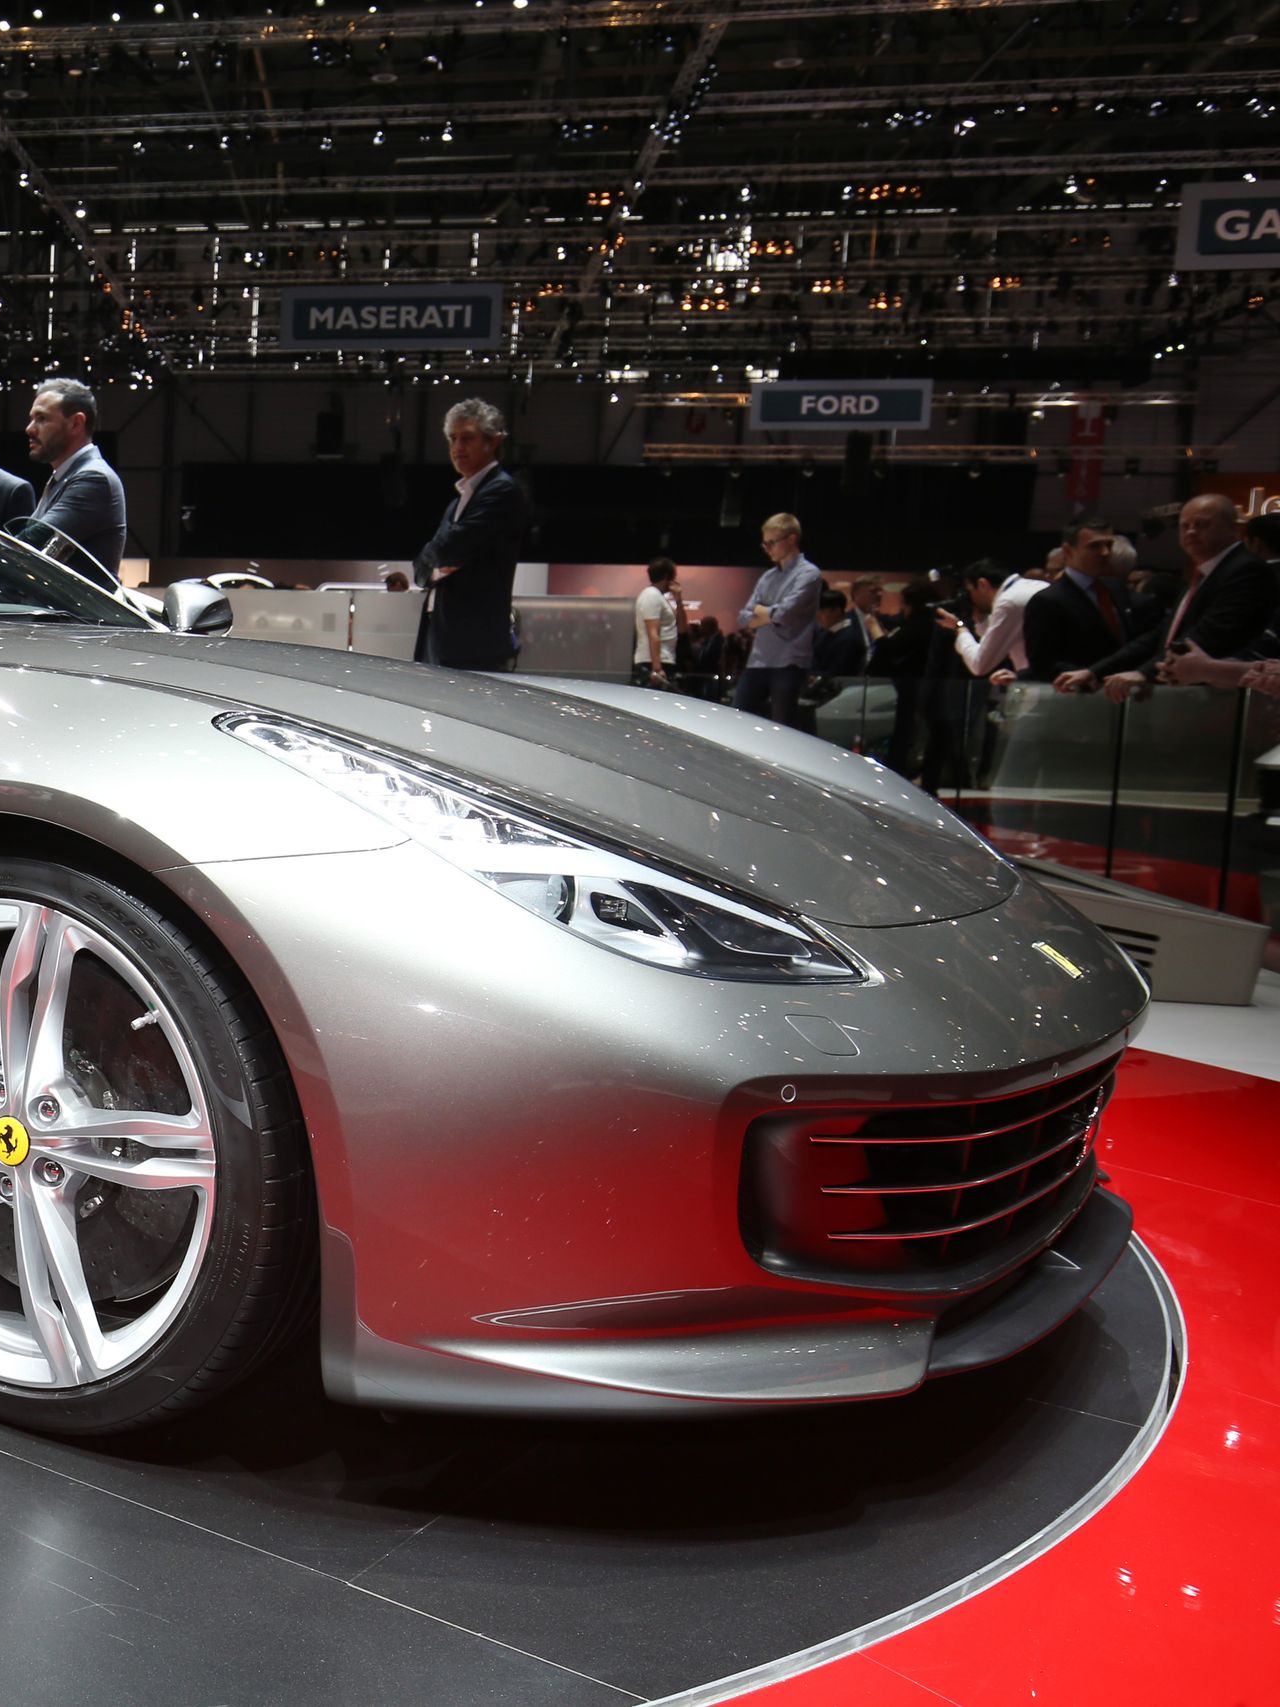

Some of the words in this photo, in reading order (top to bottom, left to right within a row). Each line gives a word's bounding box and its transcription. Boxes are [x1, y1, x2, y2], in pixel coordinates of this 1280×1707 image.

[1215, 208, 1280, 241] GA
[308, 304, 473, 330] MASERATI
[800, 394, 880, 416] FORD
